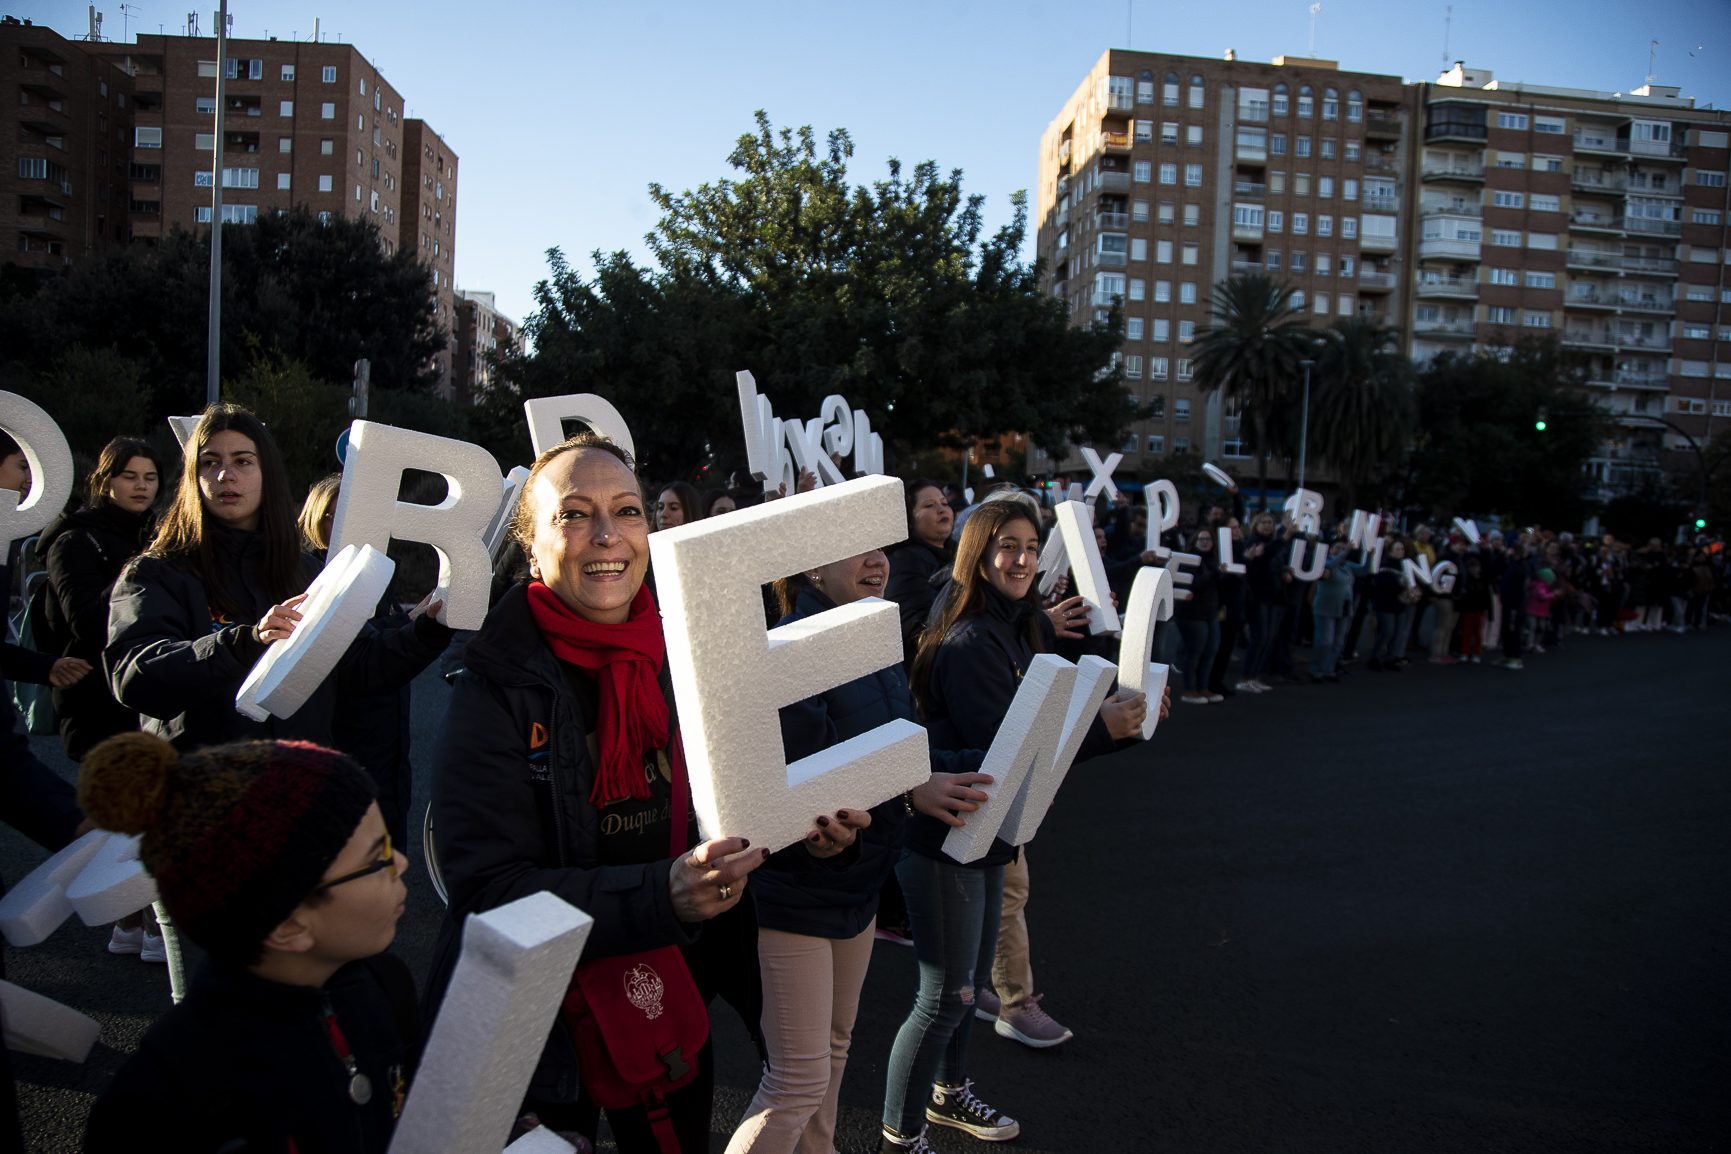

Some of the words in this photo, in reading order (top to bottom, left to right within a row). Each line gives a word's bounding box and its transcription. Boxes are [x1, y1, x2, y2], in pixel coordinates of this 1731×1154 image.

[1081, 447, 1124, 501] X
[325, 419, 504, 631] R
[1217, 527, 1247, 575] L
[1288, 538, 1330, 582] U
[1400, 553, 1433, 588] N
[1165, 551, 1203, 602] E
[1431, 560, 1459, 595] G
[647, 473, 932, 857] E
[600, 808, 658, 836] Duque
